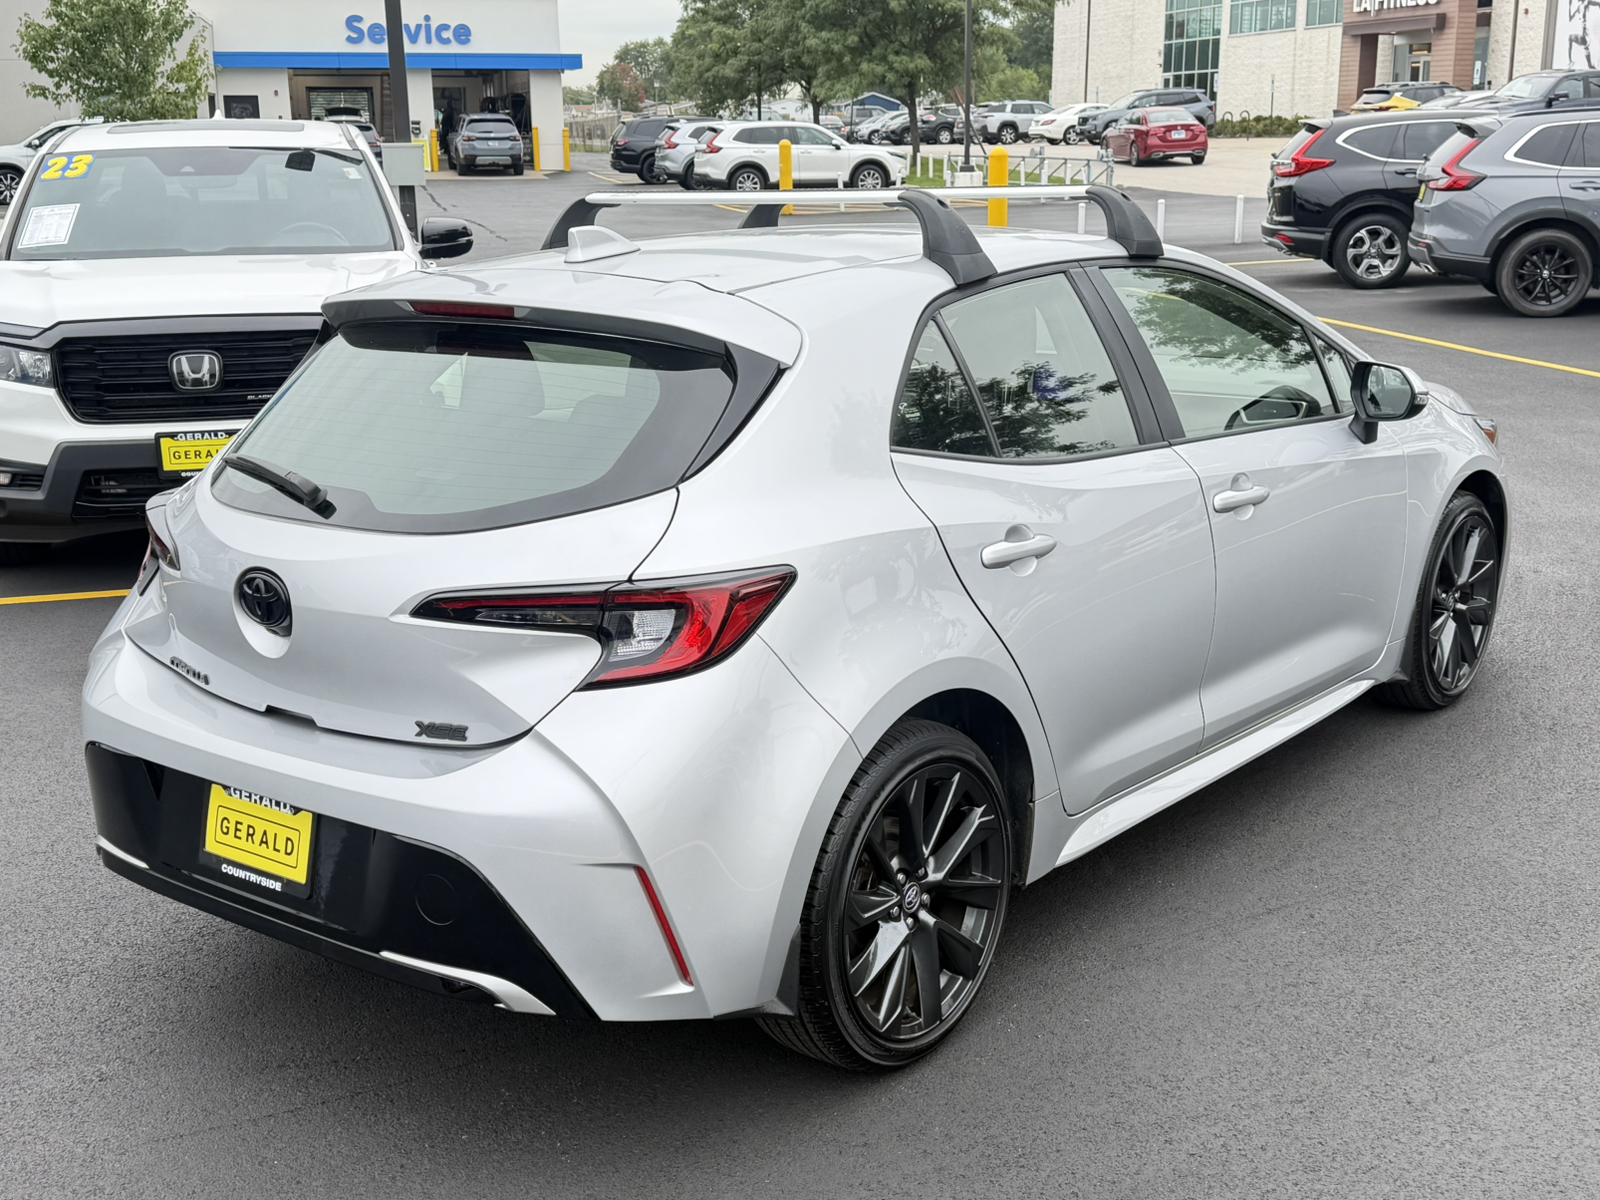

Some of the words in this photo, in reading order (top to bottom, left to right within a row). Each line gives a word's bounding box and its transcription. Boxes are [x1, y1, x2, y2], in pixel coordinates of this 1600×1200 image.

[345, 14, 472, 45] Sevice
[41, 154, 95, 180] 23
[177, 431, 226, 441] GERALD
[172, 449, 218, 460] GERA
[414, 720, 469, 742] XSE
[230, 786, 291, 815] GERALD
[220, 816, 294, 856] GERALD
[221, 863, 282, 892] COUNTRYSIDE
